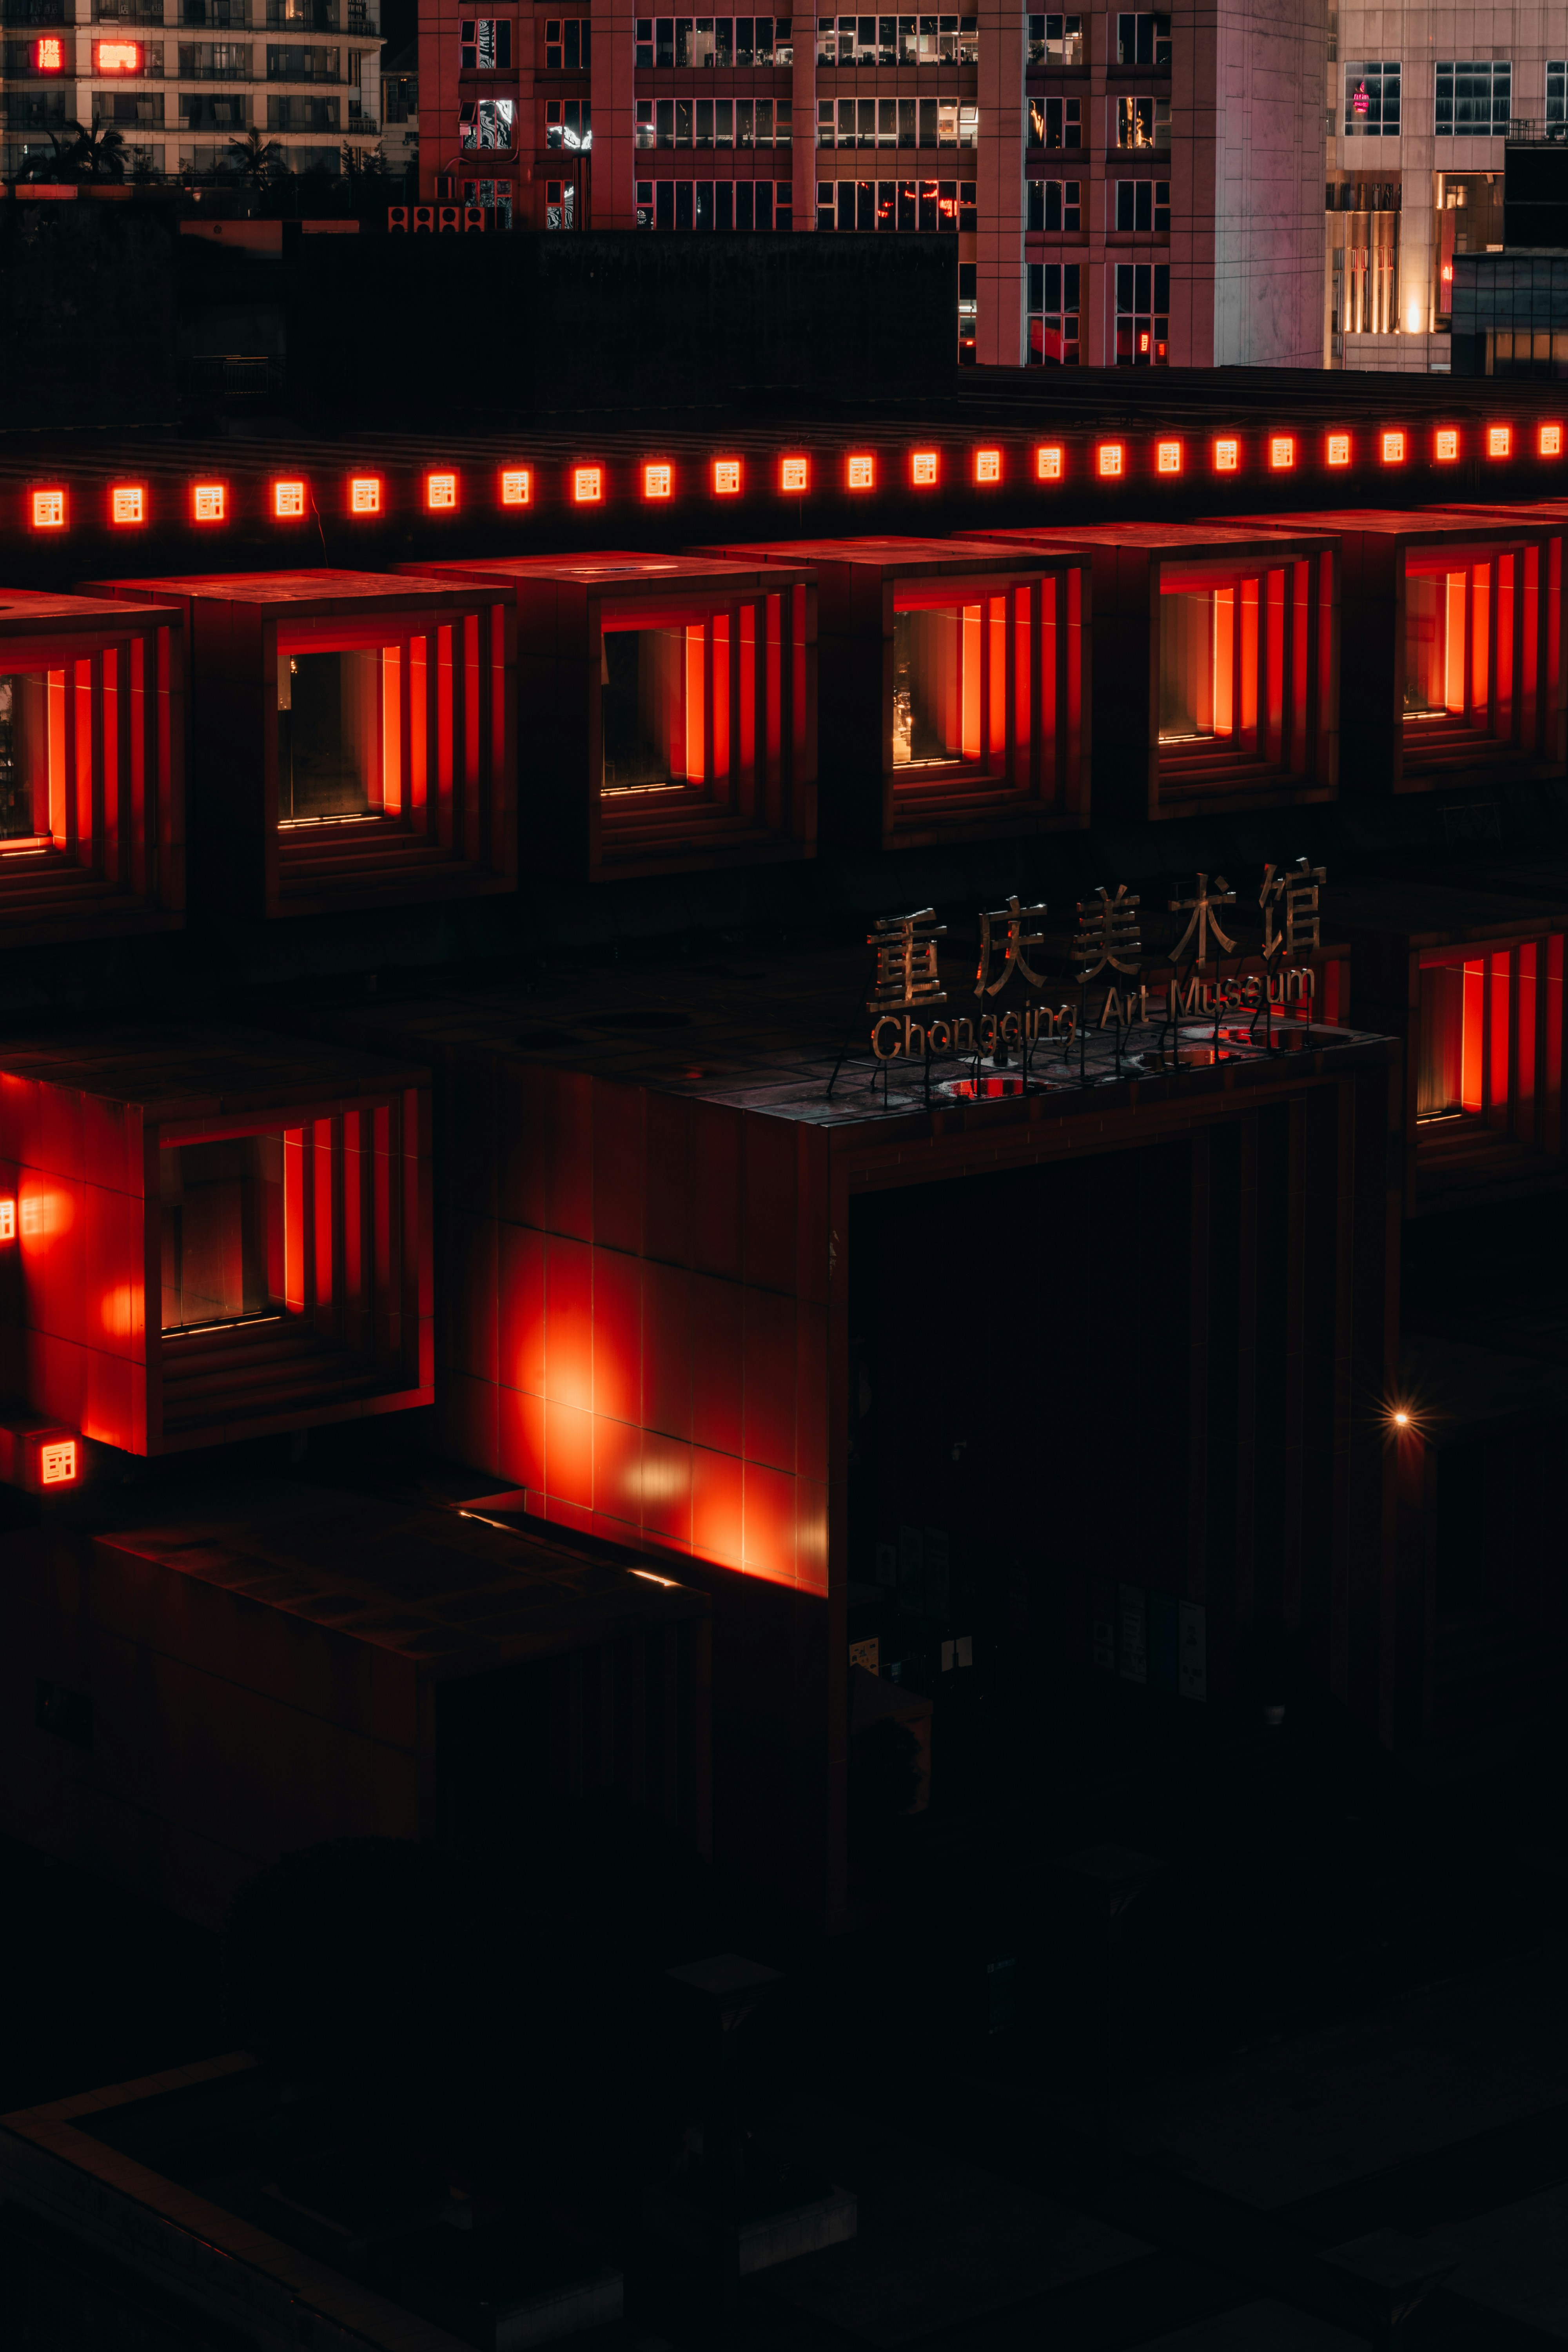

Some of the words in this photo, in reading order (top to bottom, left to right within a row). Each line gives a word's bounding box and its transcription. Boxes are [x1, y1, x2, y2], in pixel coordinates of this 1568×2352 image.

[866, 857, 1327, 1013] 重庆美术馆
[871, 1000, 1077, 1060] Chongqing
[1097, 985, 1149, 1029] Art
[1167, 968, 1315, 1022] Museum
